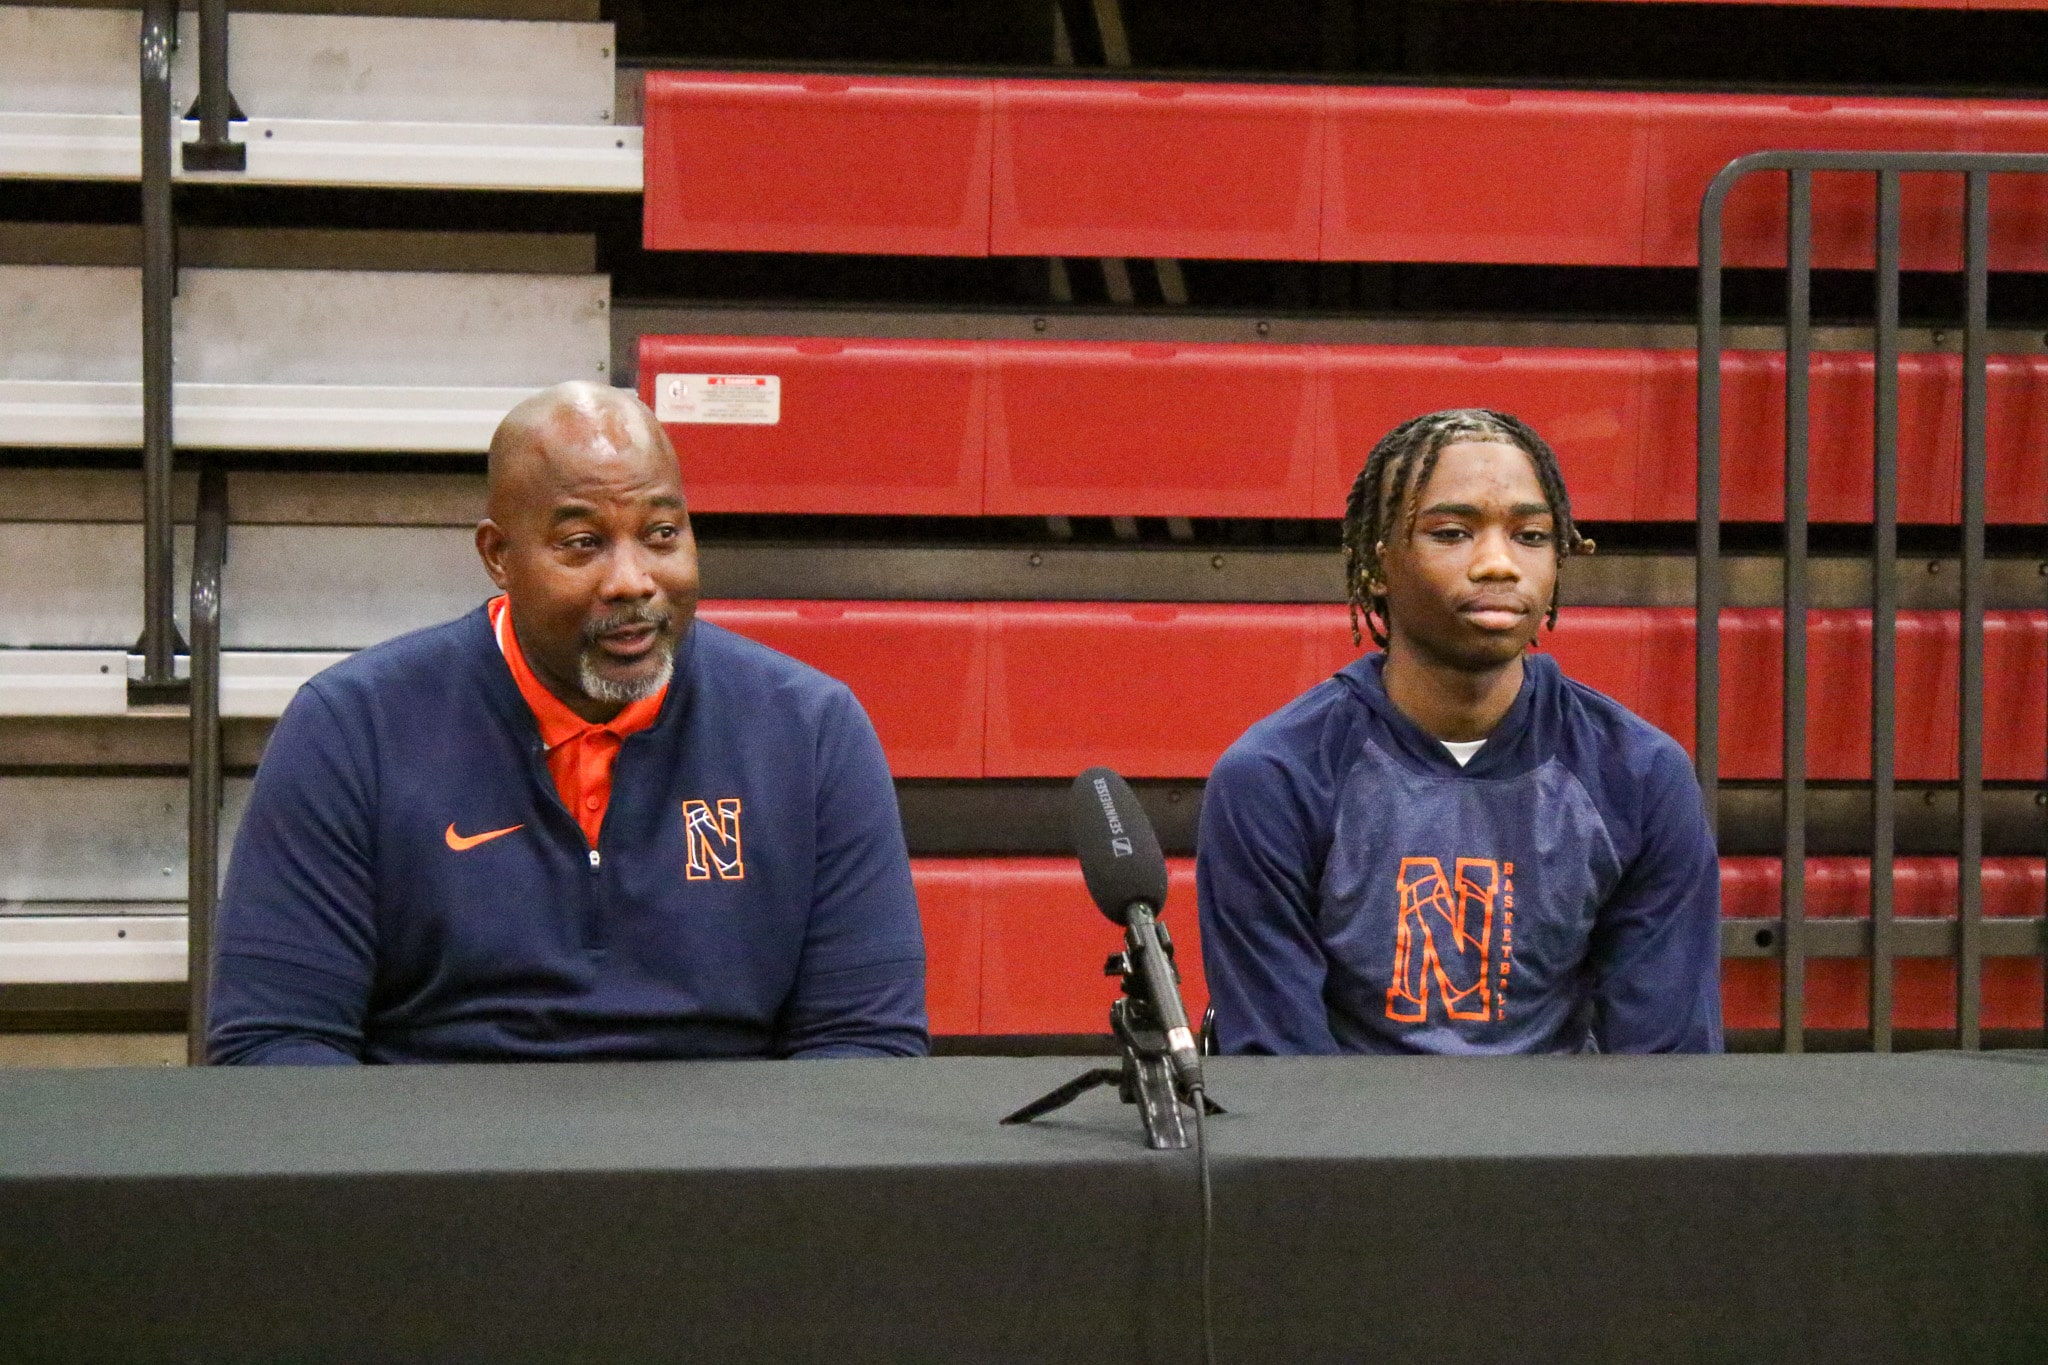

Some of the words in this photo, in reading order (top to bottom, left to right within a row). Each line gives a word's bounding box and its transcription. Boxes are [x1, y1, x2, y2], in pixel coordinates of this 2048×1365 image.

[682, 798, 744, 880] N
[1093, 778, 1124, 834] SENNHEISER
[1385, 857, 1499, 1022] N
[1497, 862, 1514, 1021] BASKETBALL
